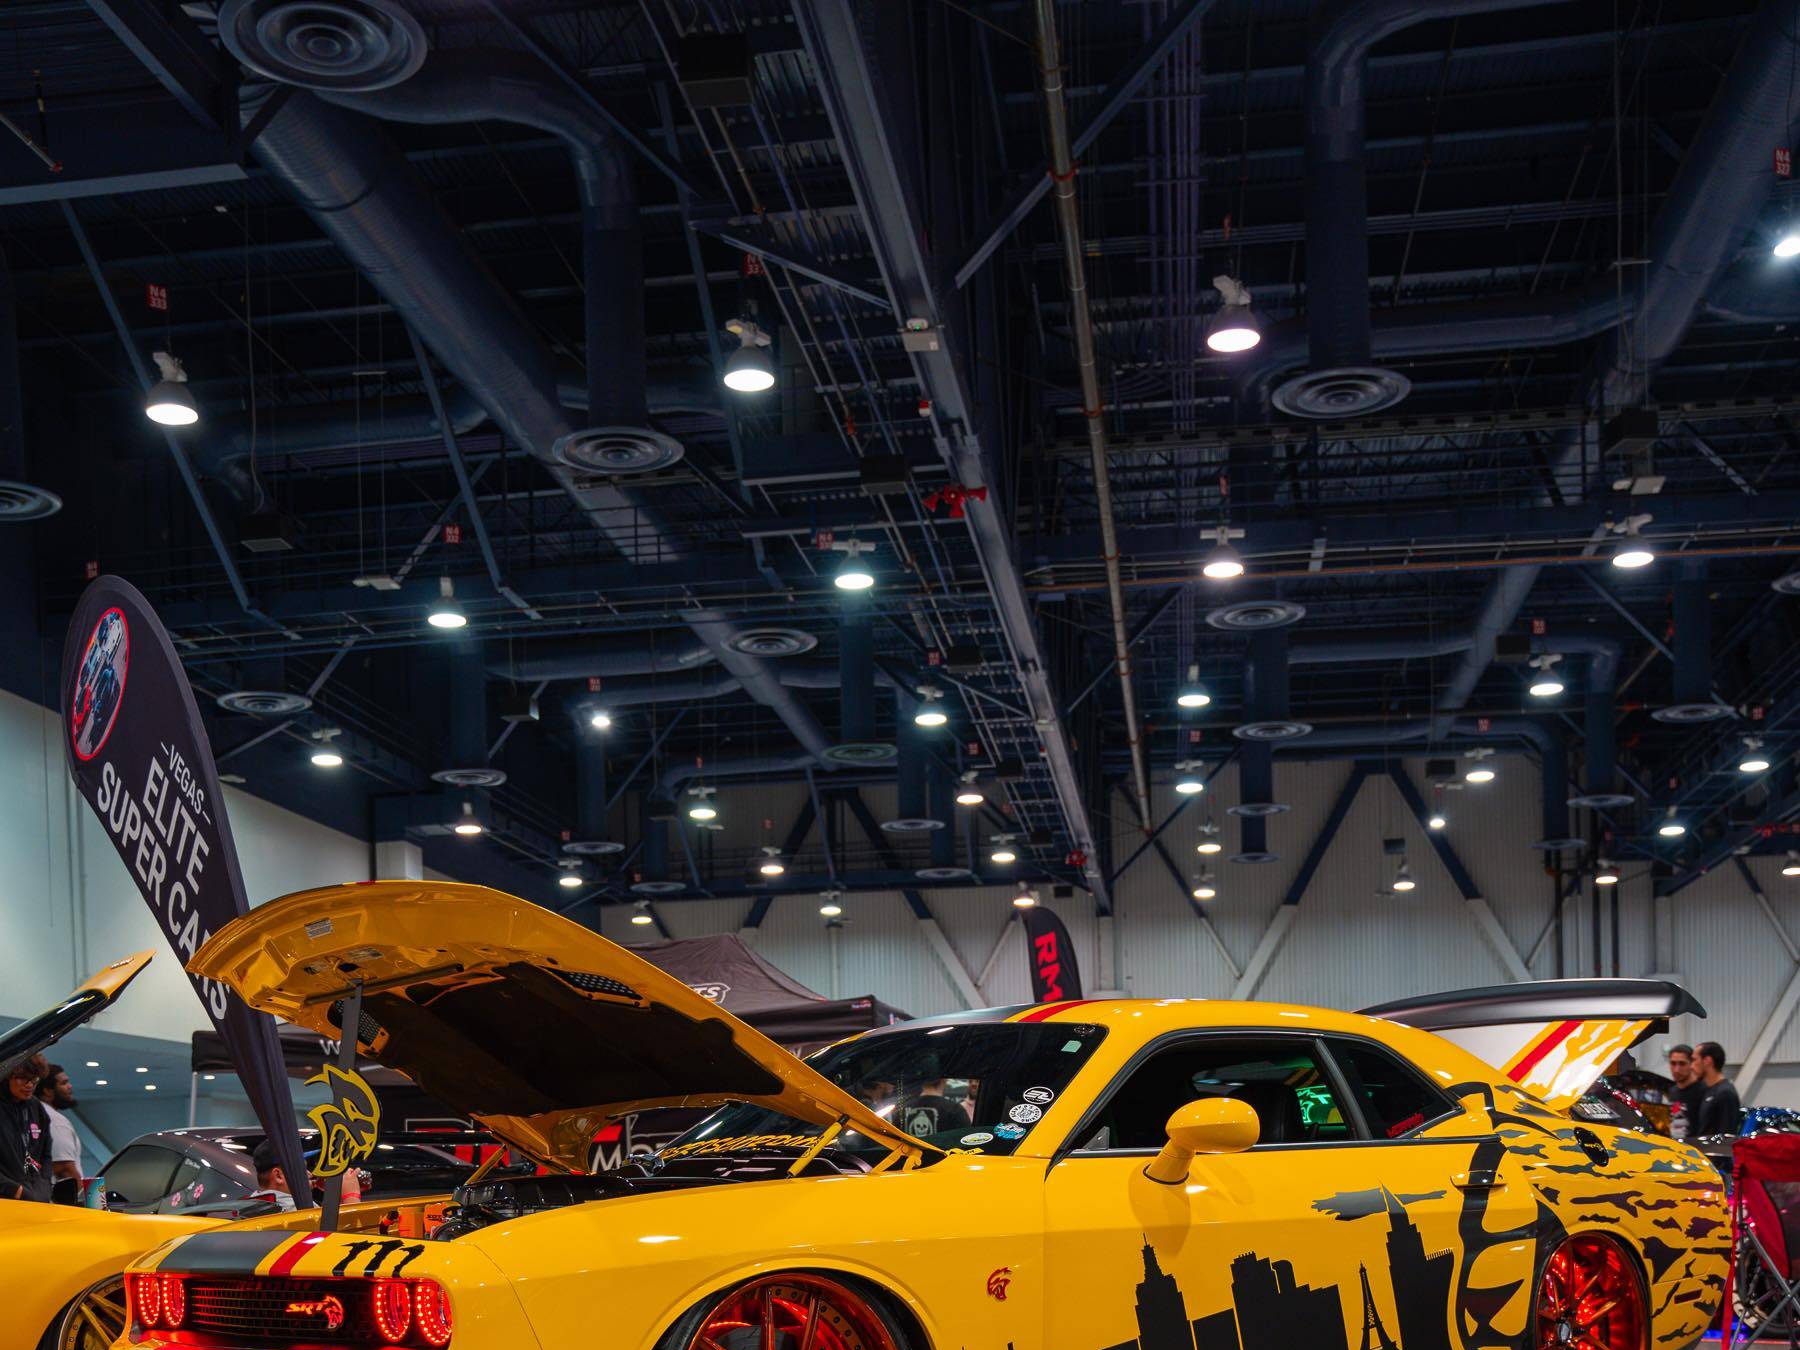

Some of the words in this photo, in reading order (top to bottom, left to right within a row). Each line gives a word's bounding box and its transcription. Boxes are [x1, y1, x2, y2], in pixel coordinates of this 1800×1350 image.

[150, 286, 167, 299] N4
[143, 757, 209, 894] ELITE
[169, 744, 204, 815] VEGAS
[98, 762, 166, 907] SUPER
